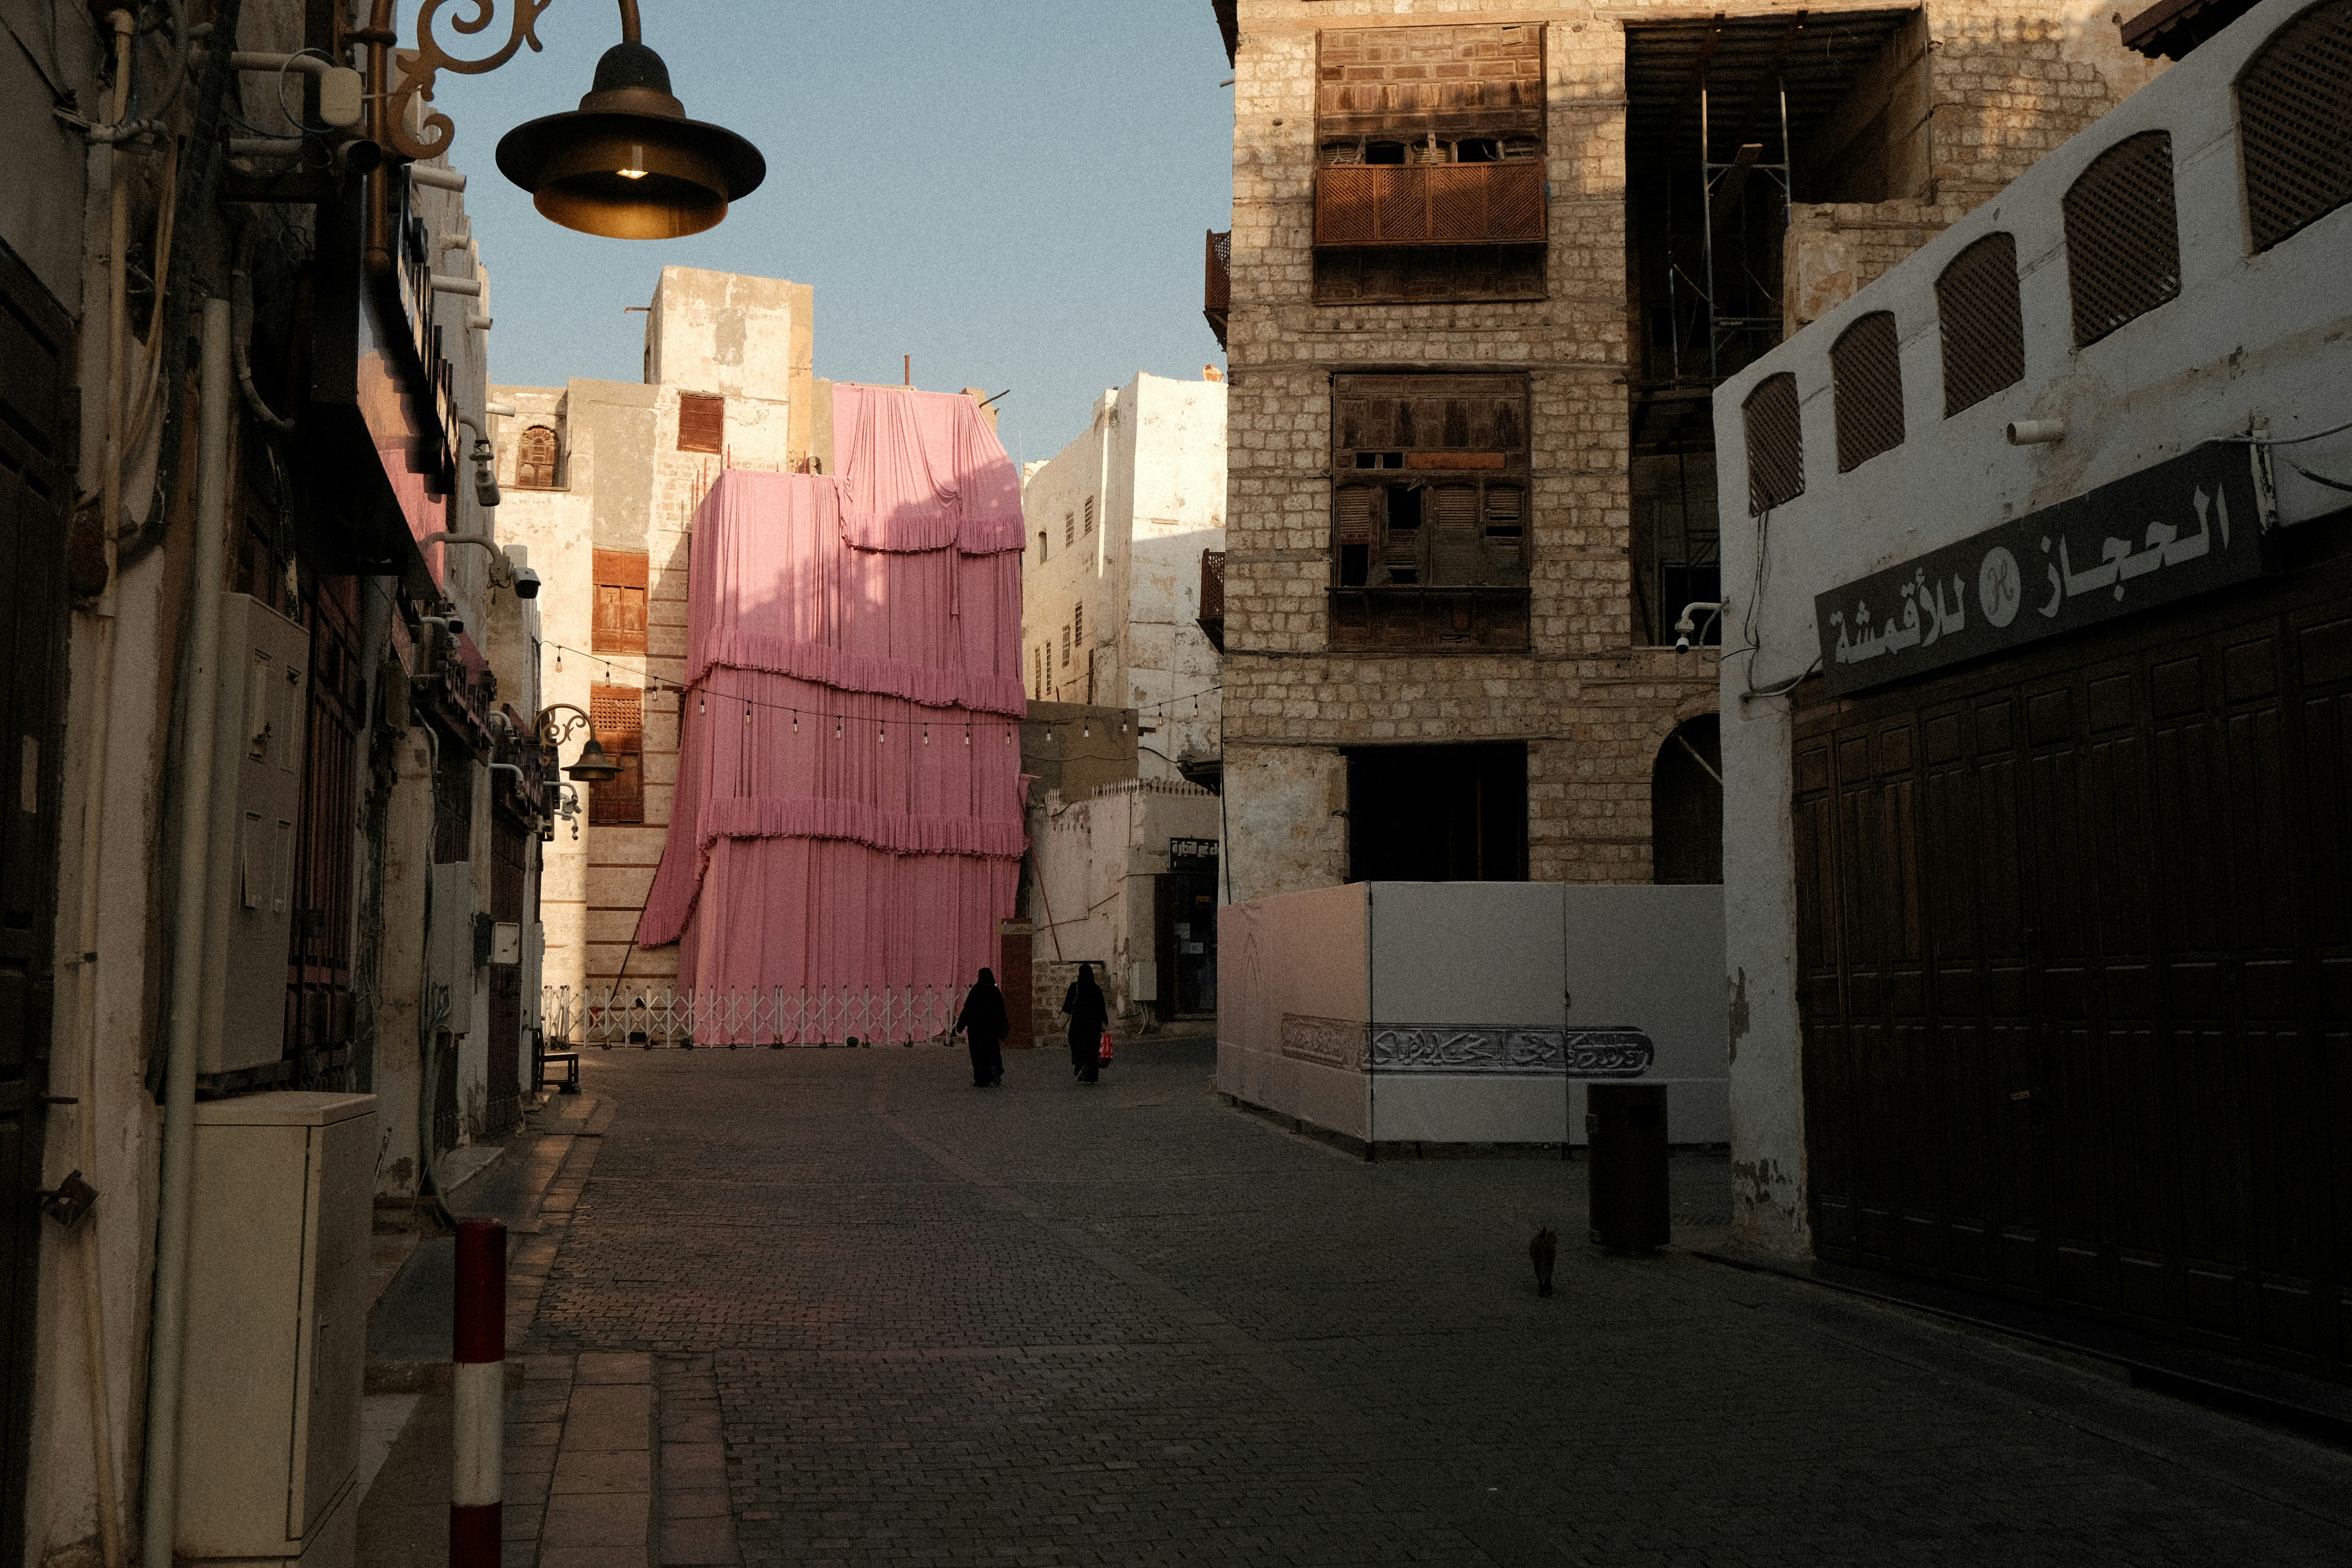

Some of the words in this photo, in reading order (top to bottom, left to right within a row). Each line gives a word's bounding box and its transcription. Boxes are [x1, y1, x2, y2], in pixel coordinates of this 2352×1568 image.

[2038, 481, 2230, 618] الحجاز
[1829, 567, 1966, 665] للأقمشة
[1171, 840, 1197, 857] للتجارة
